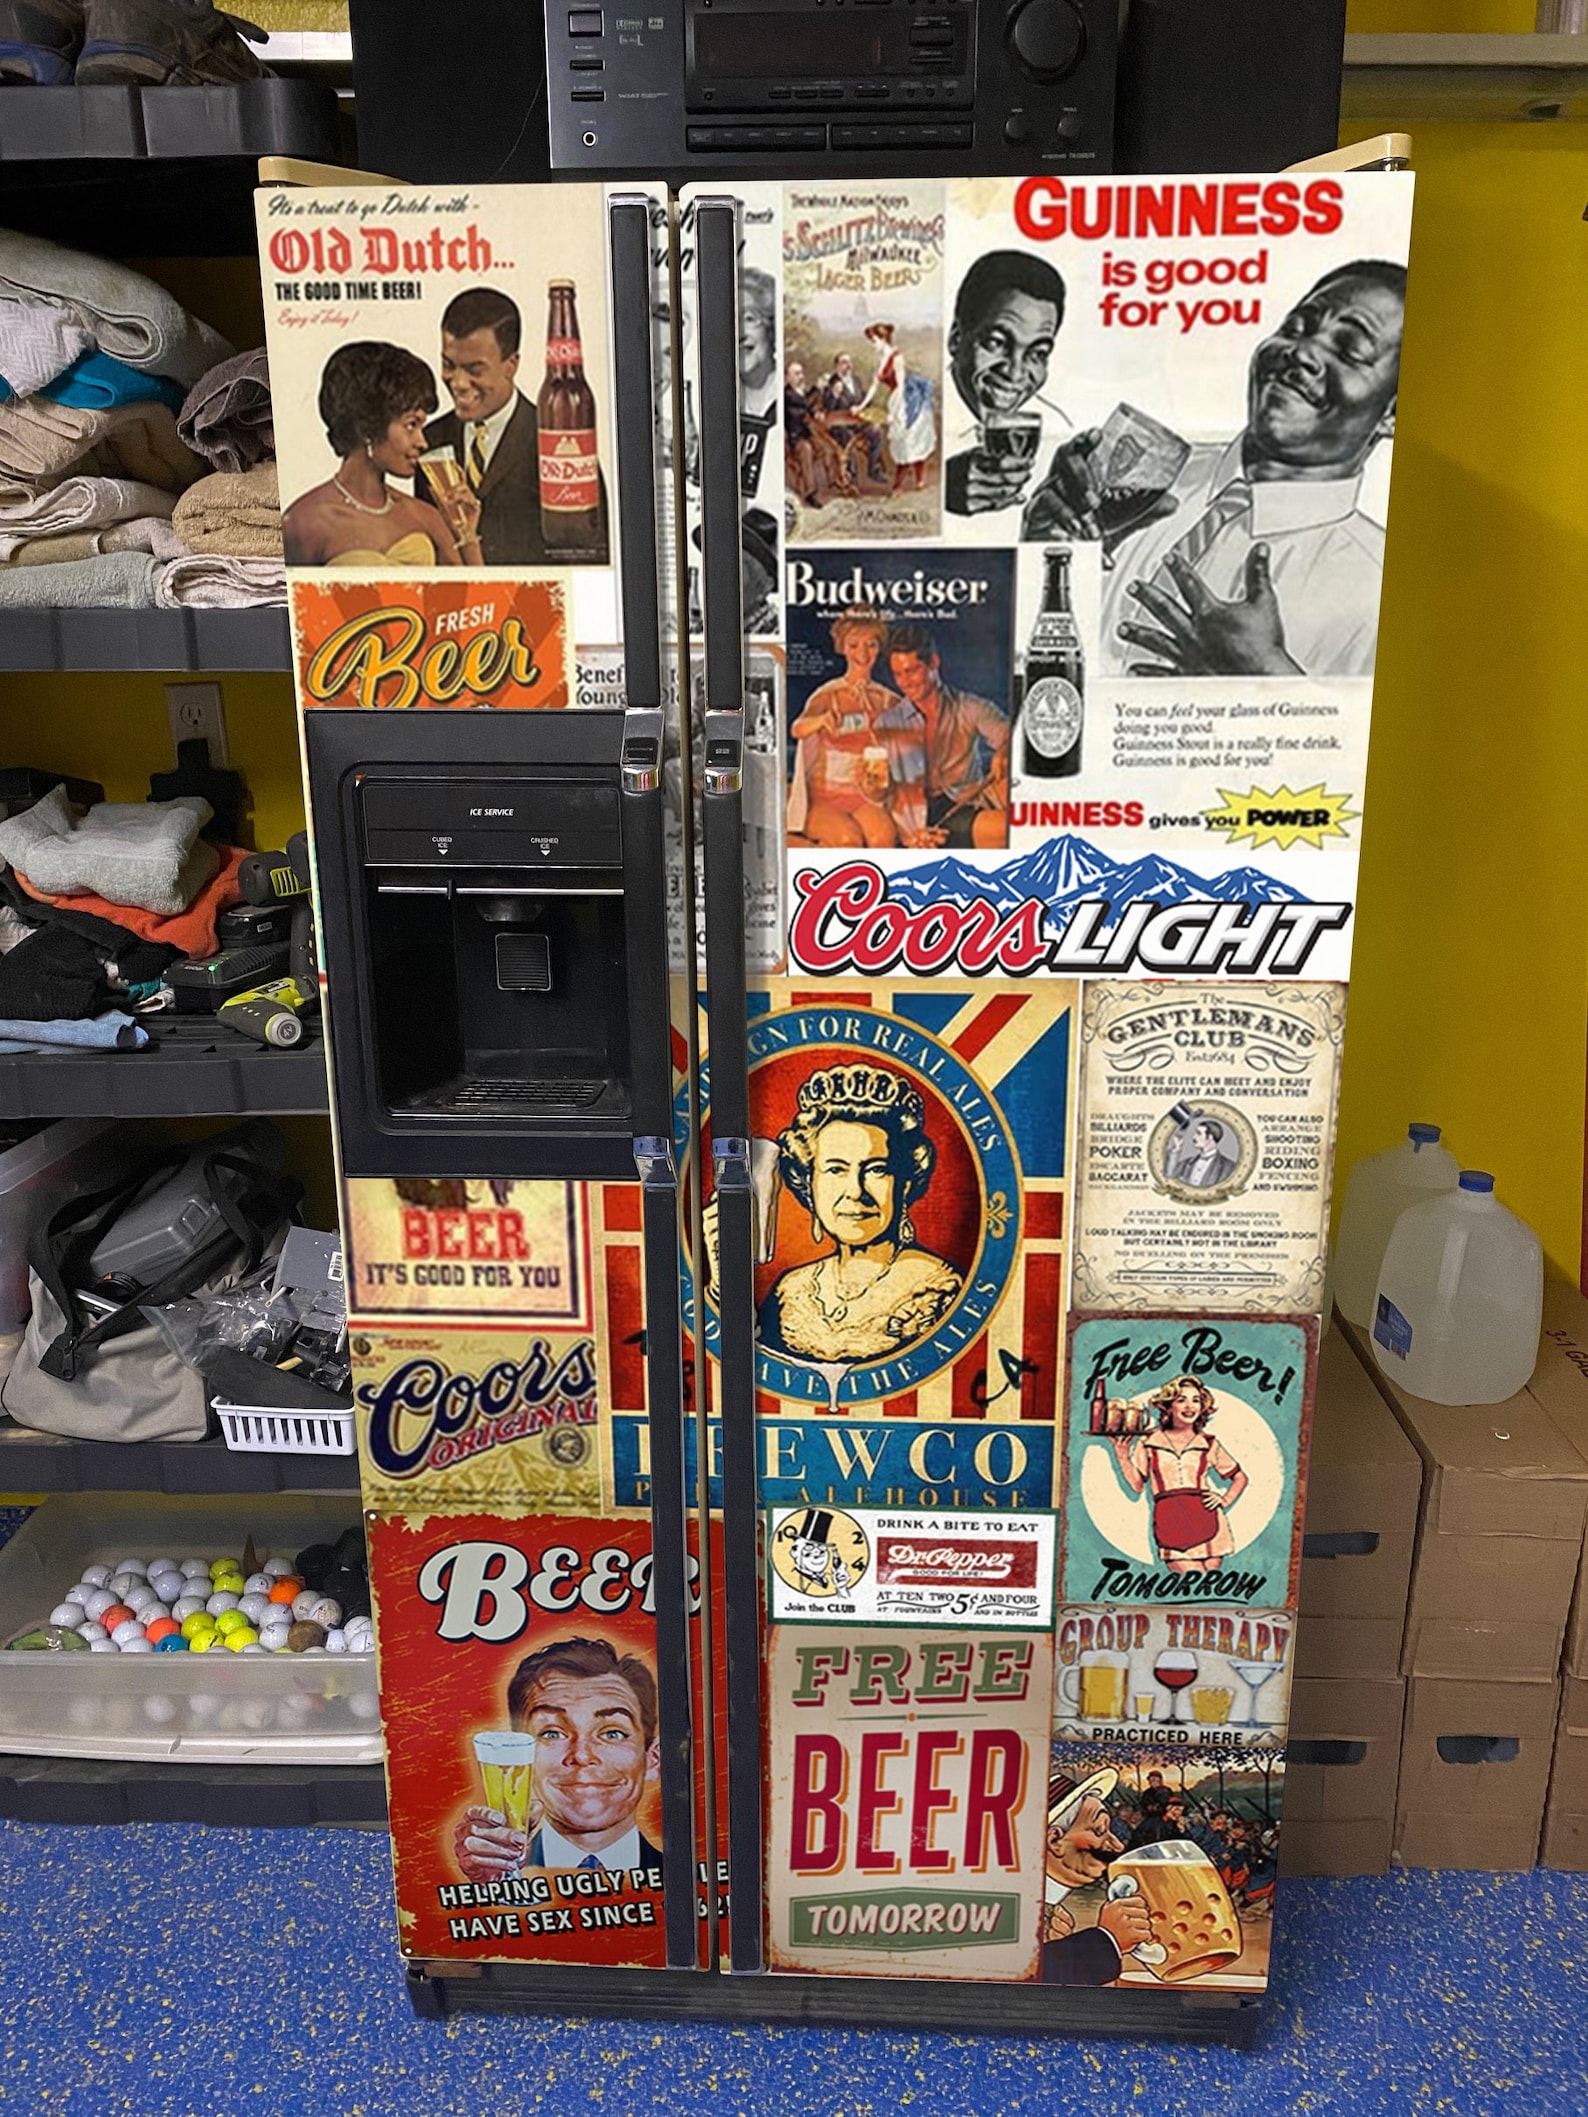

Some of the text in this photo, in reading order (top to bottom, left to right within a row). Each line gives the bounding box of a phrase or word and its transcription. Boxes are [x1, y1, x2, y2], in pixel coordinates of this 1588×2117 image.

[380, 193, 428, 215] Dutch
[1013, 176, 1344, 241] GUINNESS
[269, 226, 353, 275] Old
[1101, 249, 1269, 295] is good
[275, 281, 422, 301] THE GOOD TIME BEER!
[1099, 293, 1261, 334] for you
[786, 561, 989, 606] Budweiser
[435, 602, 496, 636] FRESH
[307, 606, 541, 708] Beer
[1115, 702, 1339, 720] You can feel your glass of Guinness
[1113, 722, 1151, 737] doing
[1153, 725, 1178, 737] you
[1112, 737, 1174, 751] Guinness
[1176, 737, 1211, 750] Stout
[1213, 738, 1224, 750] is
[1226, 741, 1235, 750] a
[1237, 736, 1273, 753] really
[1275, 736, 1300, 750] fine
[1112, 753, 1173, 767] Guinness
[1176, 754, 1186, 767] is
[1189, 753, 1221, 769] good
[1223, 753, 1242, 767] for
[470, 808, 514, 817] ICE SERVICE
[1149, 812, 1201, 830] gives
[1205, 814, 1240, 831] you
[1246, 809, 1330, 828] POWER
[790, 859, 1053, 977] Coors
[1050, 900, 1354, 975] LIGHT
[1200, 993, 1226, 1006] The
[1107, 1008, 1317, 1048] GENTLEMANS
[1173, 1029, 1247, 1048] CLUB
[799, 1015, 1003, 1153] FOR REAL ALES
[1106, 1075, 1313, 1088] WHERE THE ELITE CAN MEET AND ENJOY
[1107, 1086, 1310, 1098] PROPER COMPANY AND CONVERSATION
[1090, 1122, 1147, 1132] BILLIARDS
[1277, 1115, 1297, 1123] CAN
[1299, 1115, 1324, 1124] ALSO
[1090, 1146, 1142, 1158] POKER
[1262, 1157, 1319, 1170] BOXING
[1089, 1172, 1149, 1182] BACCARAT
[402, 1206, 531, 1262] BEER
[366, 1263, 561, 1288] IT'S GOOD FOR YOU
[845, 1278, 998, 1397] THE ALES
[1084, 1327, 1296, 1406] Free Beer!
[357, 1337, 597, 1481] Coors
[425, 1398, 598, 1471] ORIGINAL
[877, 1518, 1040, 1533] DRINK A BITE TO EAT
[852, 1531, 865, 1545] 2
[912, 1568, 937, 1576] GOOD
[1091, 1557, 1267, 1602] TOMORROW
[784, 1602, 856, 1614] Join the CLUB
[877, 1591, 893, 1601] AT
[897, 1591, 924, 1601] TEN
[930, 1592, 955, 1602] TWO
[981, 1593, 1004, 1604] AND
[1005, 1594, 1038, 1605] FOUR
[1059, 1613, 1291, 1665] GROUP THERAPY
[791, 1640, 1035, 1707] FREE
[1092, 1728, 1243, 1745] PRACTICED HERE
[789, 1728, 1030, 1877] BEER
[438, 1876, 552, 1909] HELPING
[555, 1868, 624, 1898] UGLY
[449, 1900, 655, 1941] HAVE SEX SINCE
[806, 1902, 1003, 1938] TOMORROW
